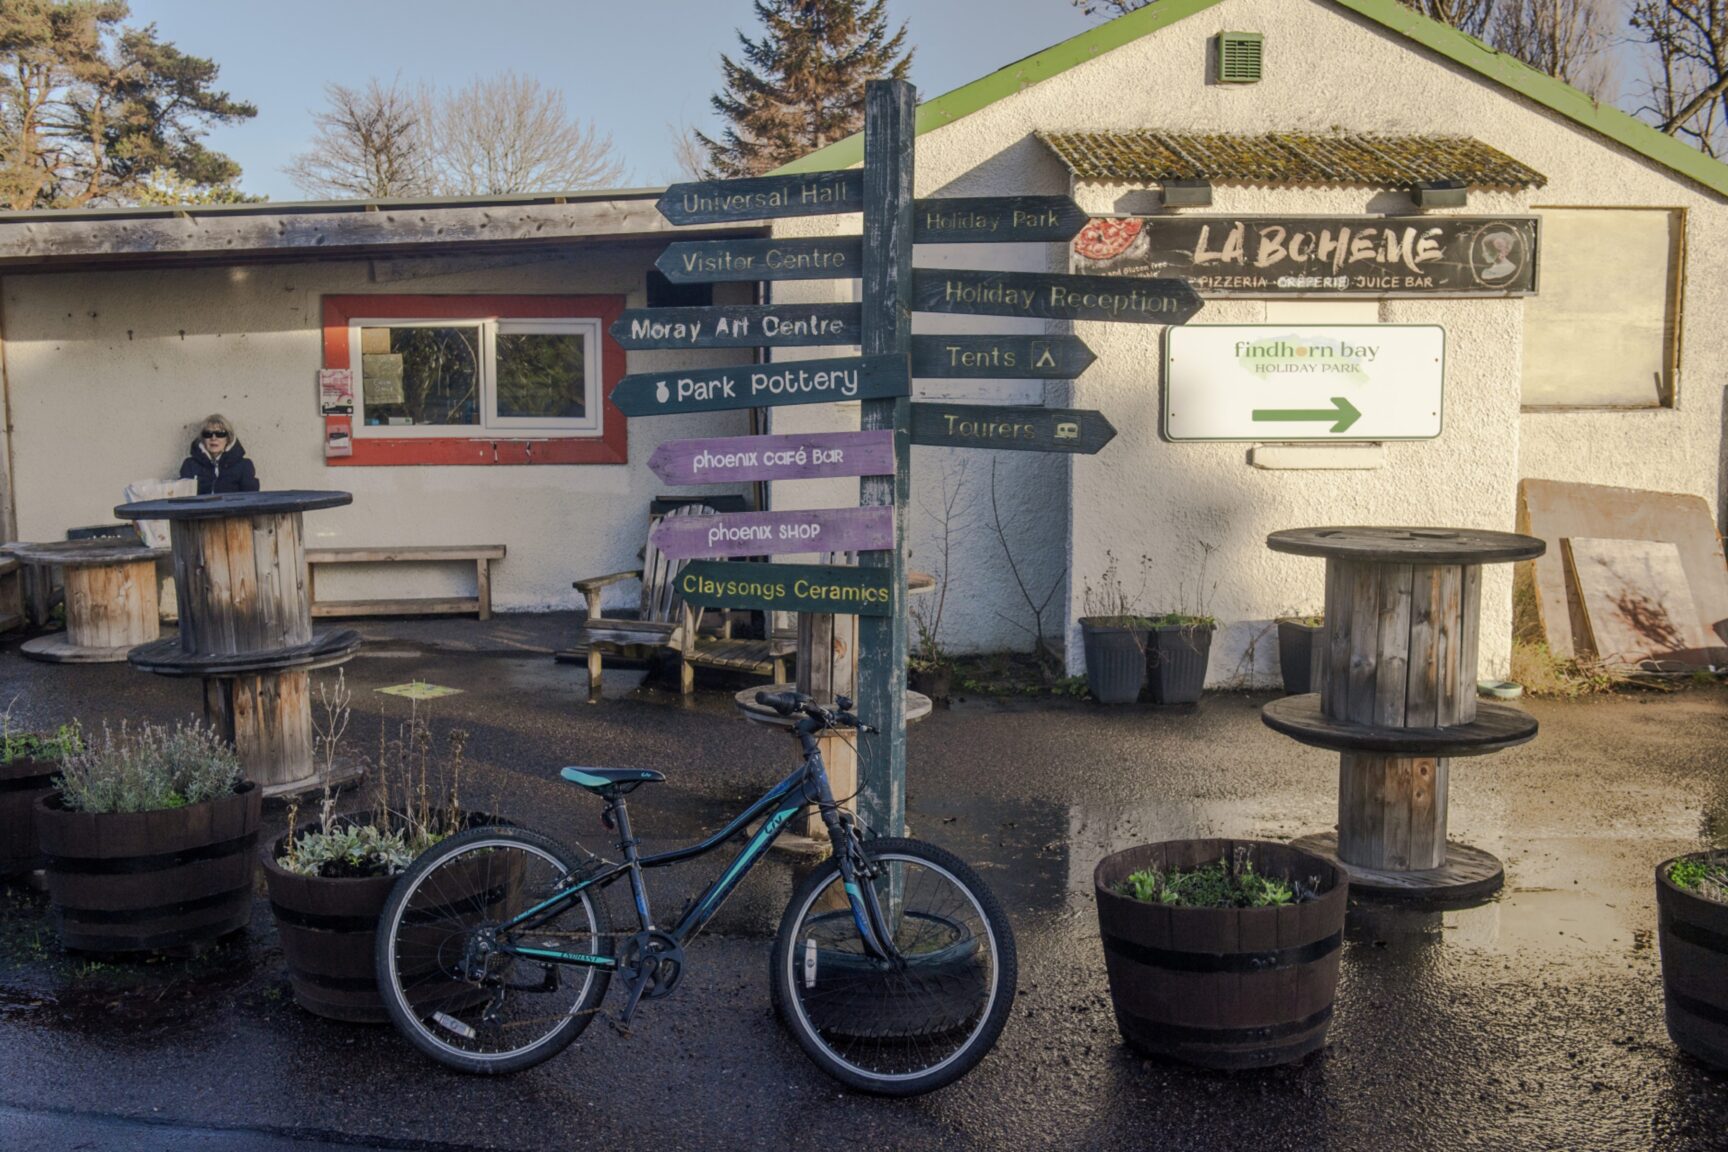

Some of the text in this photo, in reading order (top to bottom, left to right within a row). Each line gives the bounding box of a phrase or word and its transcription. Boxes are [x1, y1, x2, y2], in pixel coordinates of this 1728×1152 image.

[683, 182, 847, 213] Universal Hall
[926, 210, 1060, 232] Holiday Park
[682, 249, 846, 273] Visitor Centre
[1200, 275, 1267, 289] PIZZERIA
[1357, 276, 1400, 289] JUICE
[1404, 276, 1434, 289] BAR
[946, 281, 1179, 315] Holiday Reception
[631, 314, 845, 343] Moray Art Centre
[946, 346, 1017, 368] Tents
[1341, 341, 1380, 362] bay
[1255, 363, 1361, 373] HOLIDAY PARK
[944, 414, 1036, 438] Tourers
[693, 450, 758, 473] phoenix
[708, 523, 821, 547] phoenix SHOP
[682, 575, 890, 603] Claysongs Ceramics
